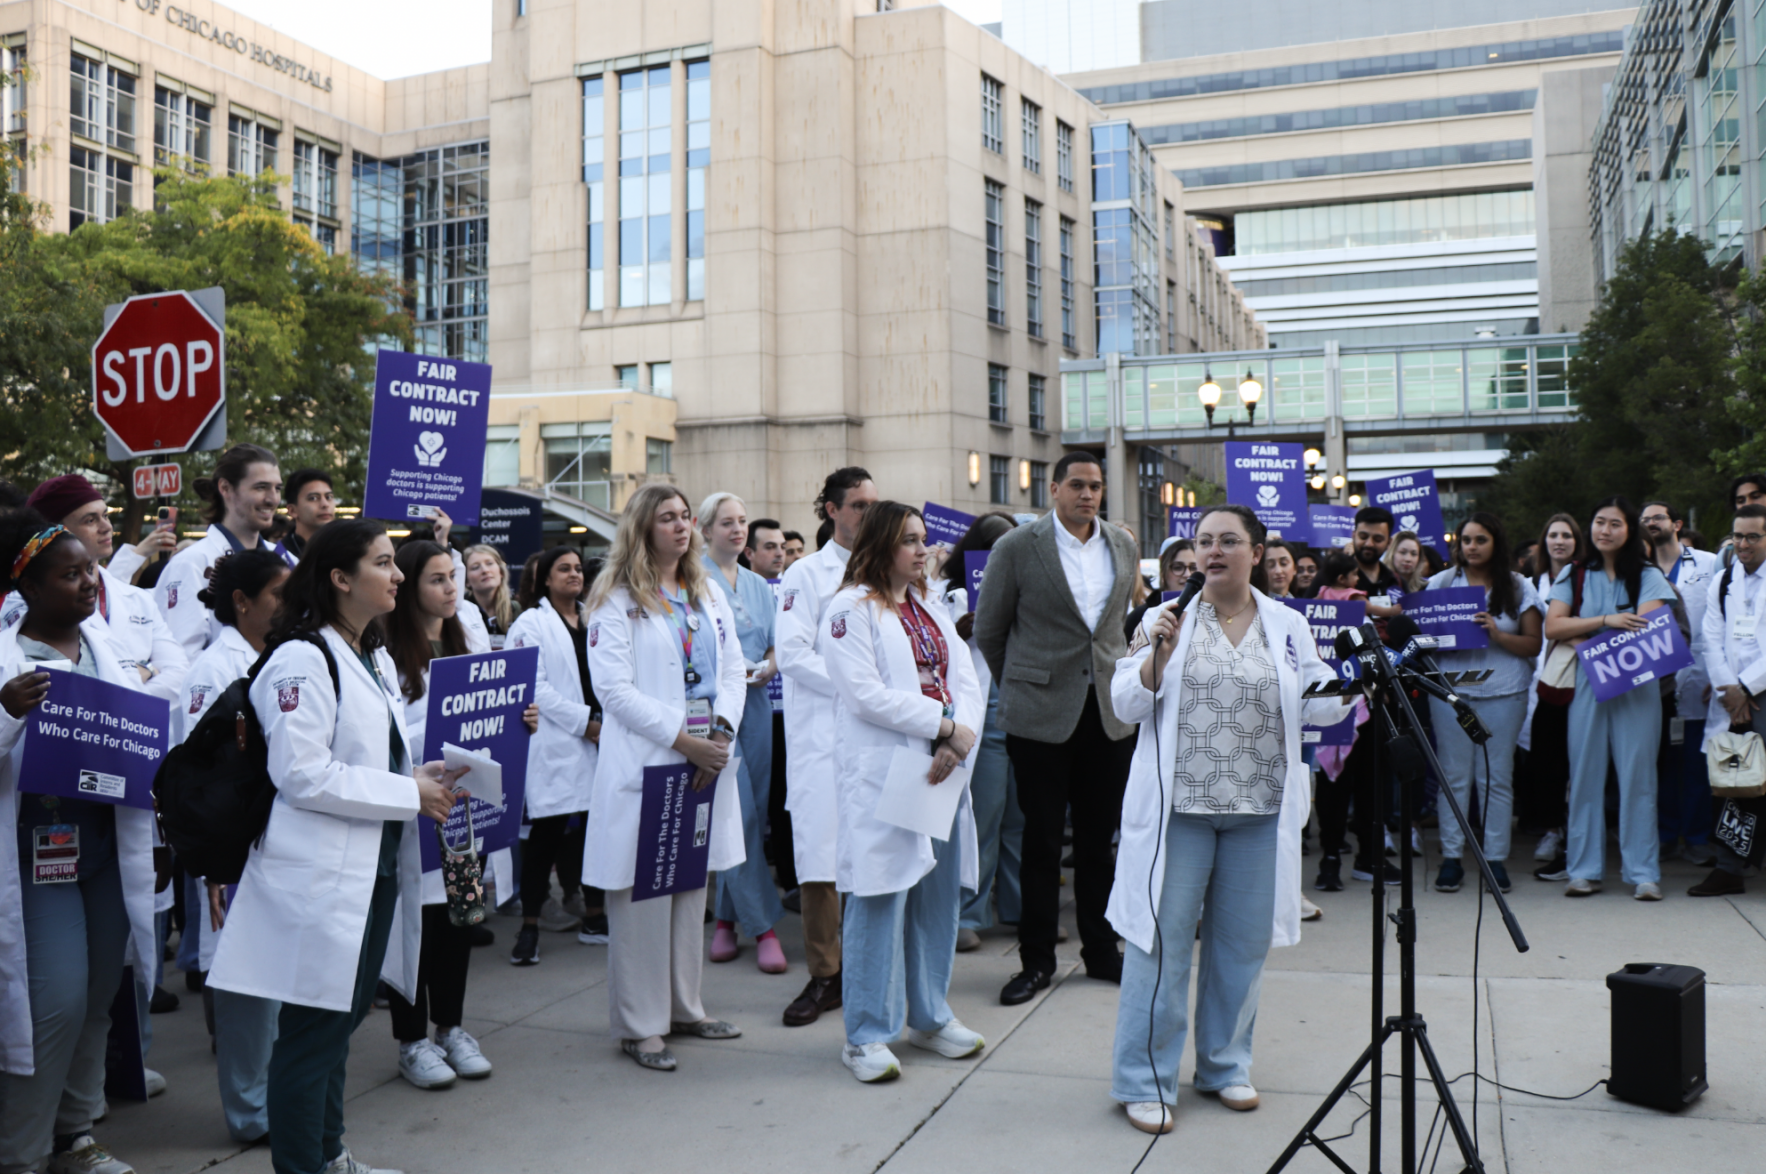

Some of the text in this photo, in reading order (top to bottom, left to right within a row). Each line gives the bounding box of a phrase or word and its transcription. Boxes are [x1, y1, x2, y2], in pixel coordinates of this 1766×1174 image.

[165, 5, 247, 54] CHICAGO
[250, 42, 332, 93] HOSPITALS
[102, 340, 213, 407] STOP
[417, 360, 457, 381] FAIR
[389, 380, 480, 406] CONTRACT
[409, 405, 457, 426] NOW!
[1251, 445, 1279, 456] FAIR
[1234, 458, 1297, 469] CONTRACT
[390, 468, 463, 484] Supporting Chicago
[1250, 471, 1284, 482] NOW!
[1388, 475, 1414, 489] FAIR
[386, 478, 465, 494] doctors is supporting
[393, 488, 458, 502] Chicago patients!
[1376, 485, 1431, 504] CONTRACT
[481, 506, 531, 517] Duchossois
[1172, 511, 1191, 519] FAIR
[1391, 500, 1421, 514] NOW!
[481, 520, 511, 529] Center
[925, 512, 960, 528] Care For The
[936, 524, 949, 533] Care
[949, 528, 959, 536] For
[481, 534, 509, 544] DCAM
[1305, 604, 1337, 619] FAIR
[1420, 605, 1433, 613] For
[1433, 604, 1446, 612] The
[1447, 603, 1478, 611] Doctors
[1421, 616, 1438, 624] Care
[1450, 613, 1476, 622] Chicag
[1583, 642, 1609, 660] FAIR
[1592, 628, 1674, 684] NOW
[469, 659, 507, 683] FAIR
[1341, 660, 1355, 682] 9
[441, 683, 527, 716] CONTRACT
[40, 700, 159, 738] Care For The Doctors
[459, 715, 505, 742] NOW!
[39, 721, 161, 761] Who Care For Chicago
[652, 775, 674, 890] Care For The Doctors
[665, 772, 688, 888] Who Care For Chicago
[1719, 825, 1749, 851] 2025
[39, 863, 76, 875] DOCTOR
